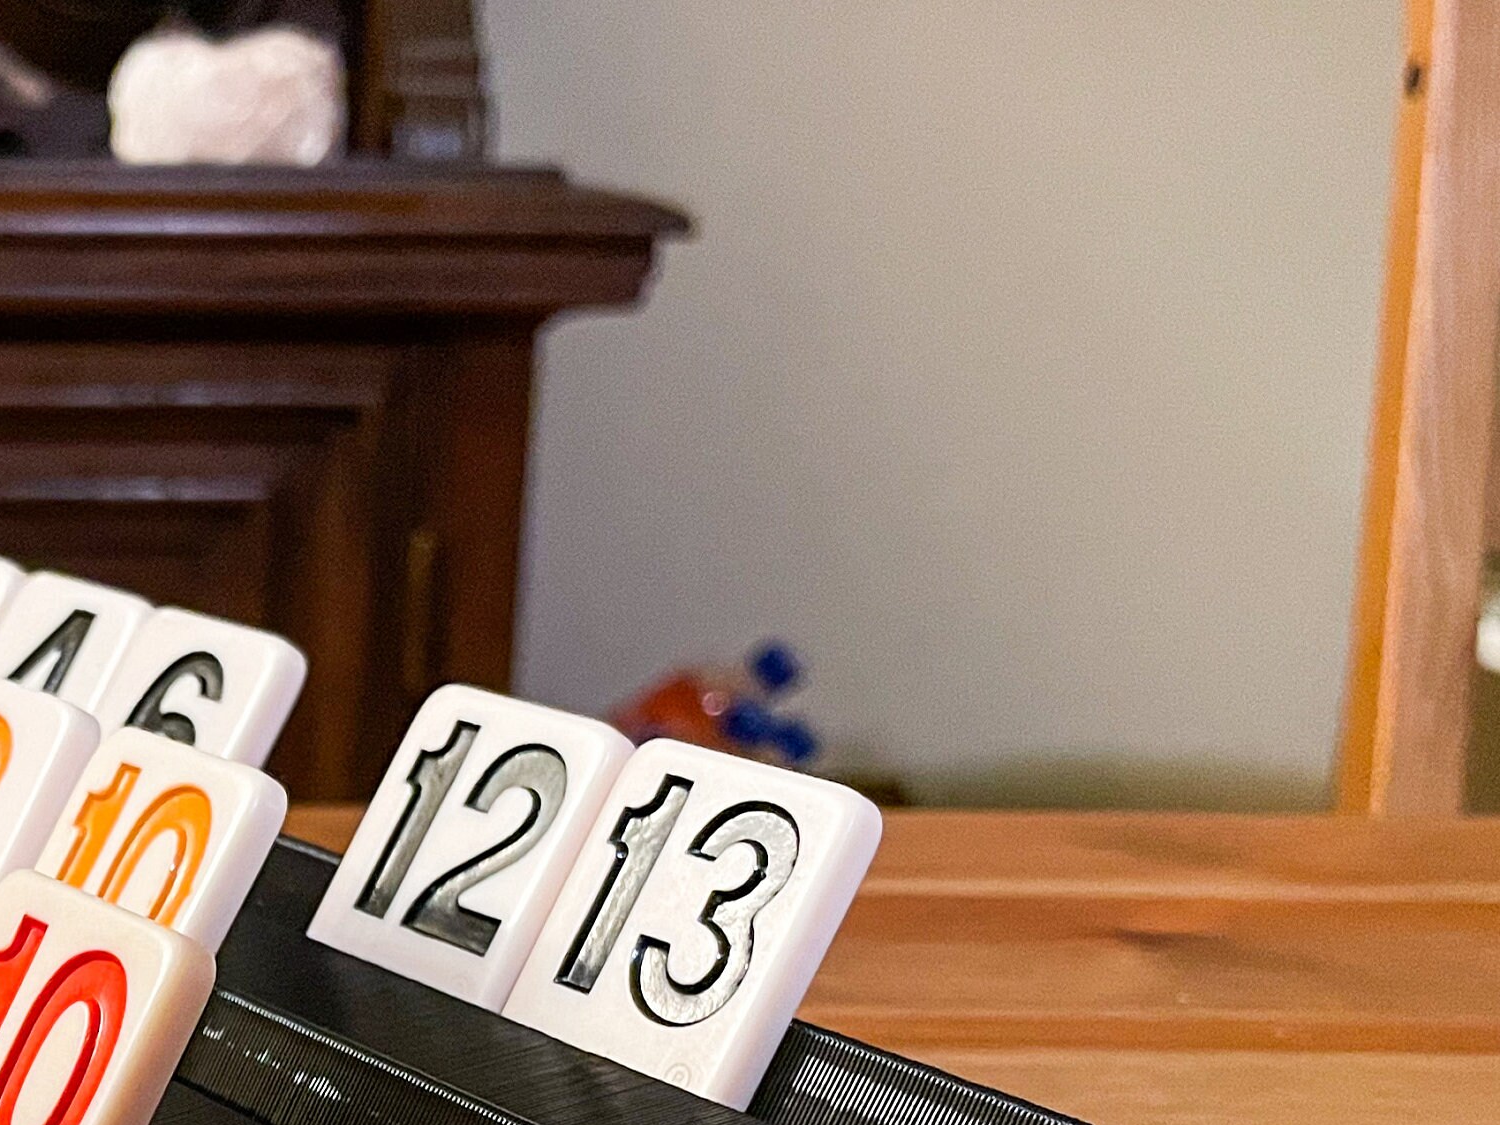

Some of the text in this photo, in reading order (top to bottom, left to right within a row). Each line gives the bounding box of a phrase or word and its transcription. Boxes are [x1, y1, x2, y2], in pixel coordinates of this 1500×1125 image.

[8, 609, 98, 694] 4
[56, 762, 214, 928] 10
[354, 720, 568, 957] 12
[554, 773, 801, 1028] 13
